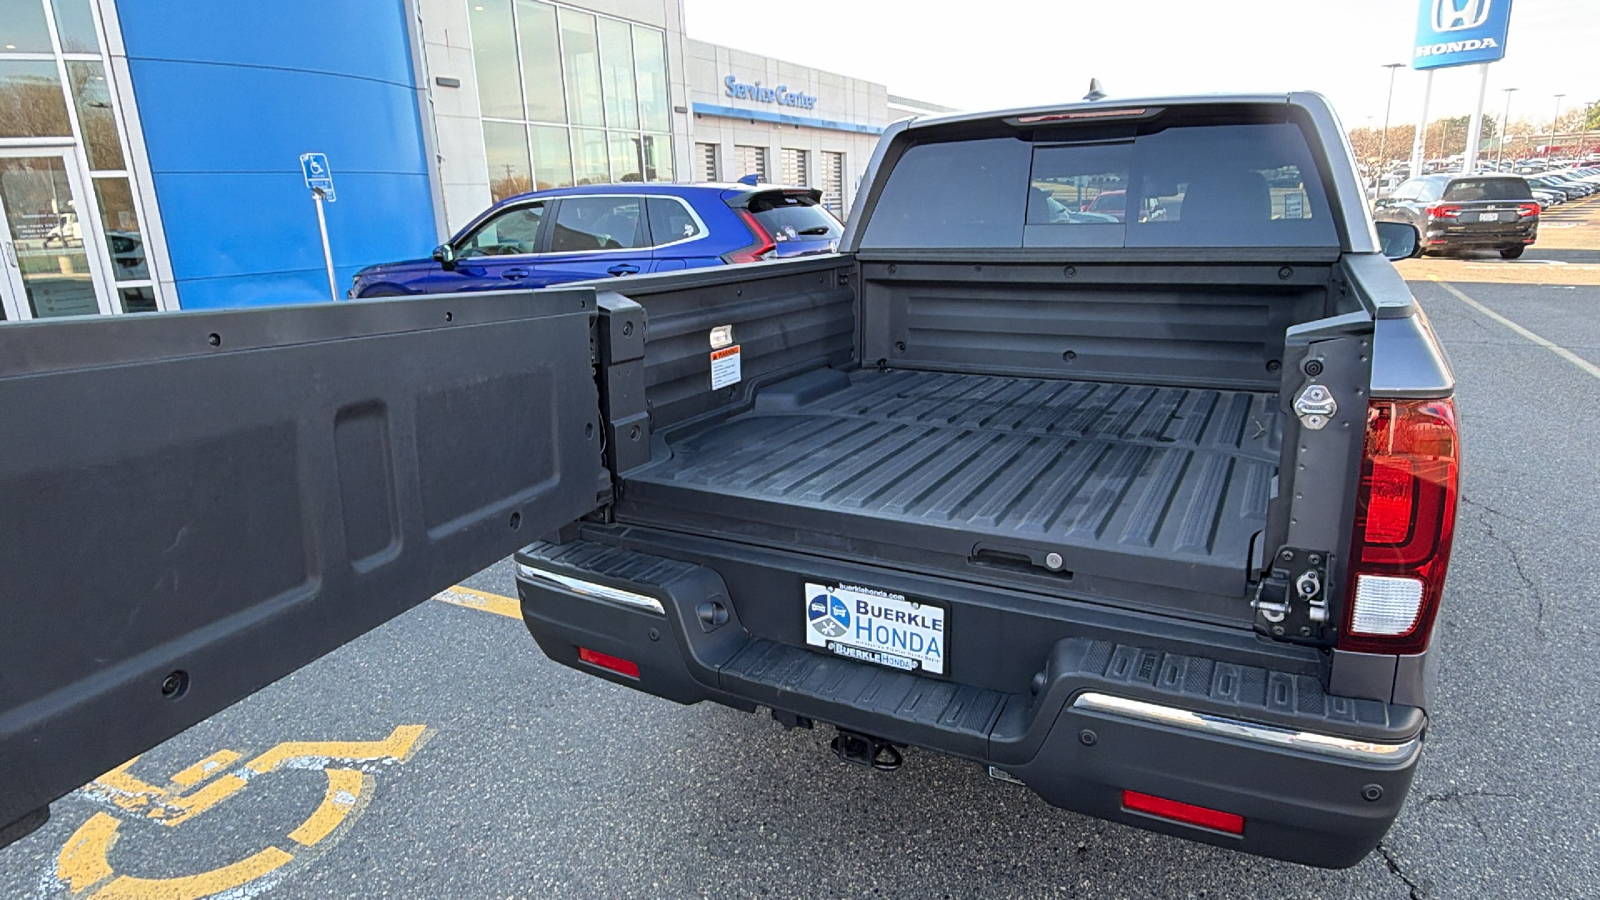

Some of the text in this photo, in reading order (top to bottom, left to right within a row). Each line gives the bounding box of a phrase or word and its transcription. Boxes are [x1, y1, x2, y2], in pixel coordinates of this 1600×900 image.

[1415, 37, 1499, 58] HONDA
[724, 74, 818, 110] Service Center
[839, 582, 906, 602] buerklehonda.com
[856, 599, 943, 633] BUERKLE
[855, 615, 942, 659] HONDA
[837, 643, 912, 670] BUERKLE HONDA
